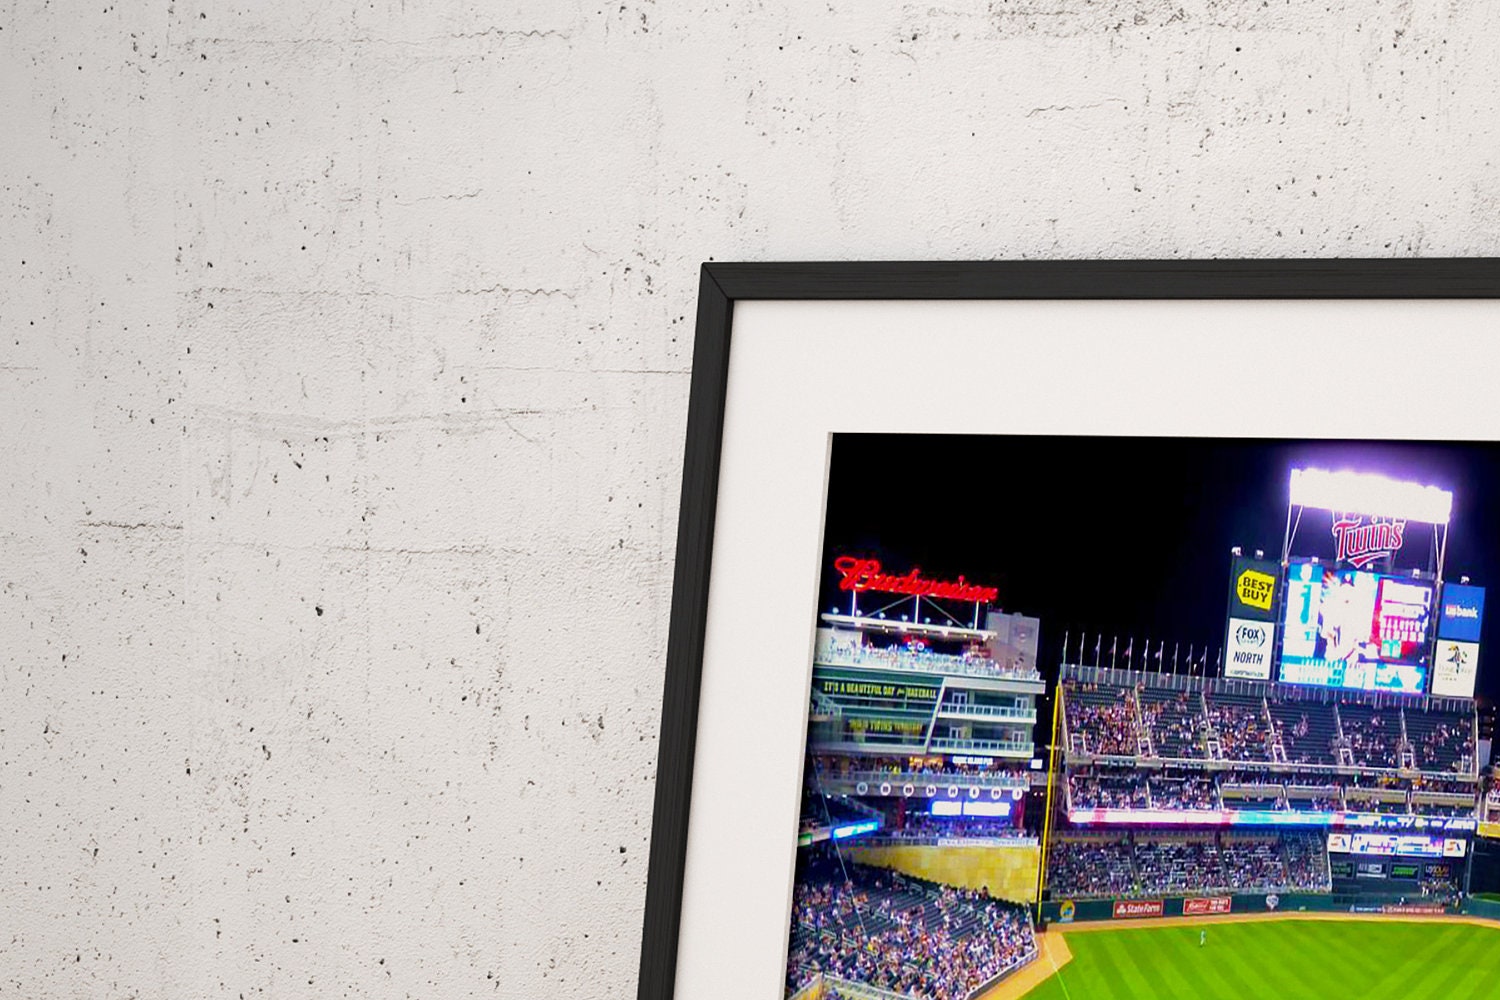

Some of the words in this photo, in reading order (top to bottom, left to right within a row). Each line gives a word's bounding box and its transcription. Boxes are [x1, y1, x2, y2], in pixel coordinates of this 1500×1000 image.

[1332, 520, 1403, 562] Twins
[835, 556, 998, 603] Budweiser
[1243, 577, 1272, 593] BEST
[1242, 588, 1268, 602] BUY
[1241, 627, 1260, 640] FOX
[1233, 651, 1263, 665] NORTH
